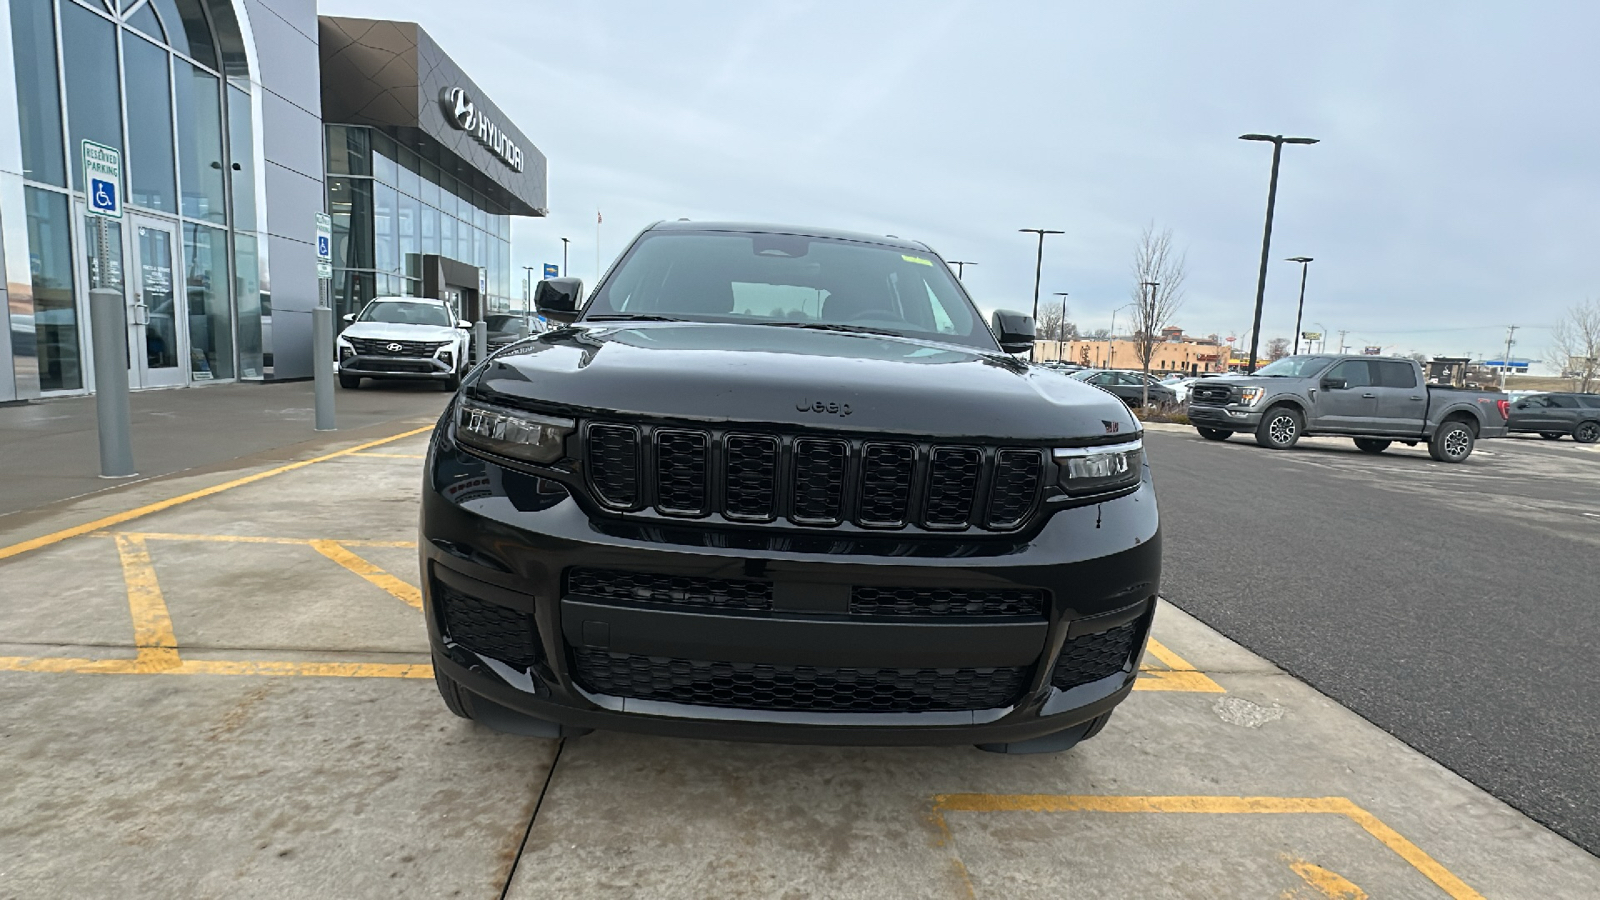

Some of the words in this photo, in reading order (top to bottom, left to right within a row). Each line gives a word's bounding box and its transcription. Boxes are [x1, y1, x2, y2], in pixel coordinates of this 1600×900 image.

[478, 110, 523, 173] HYUNDAI
[86, 147, 117, 165] RESERVED
[87, 160, 118, 178] PARKING
[796, 397, 853, 417] Jeep
